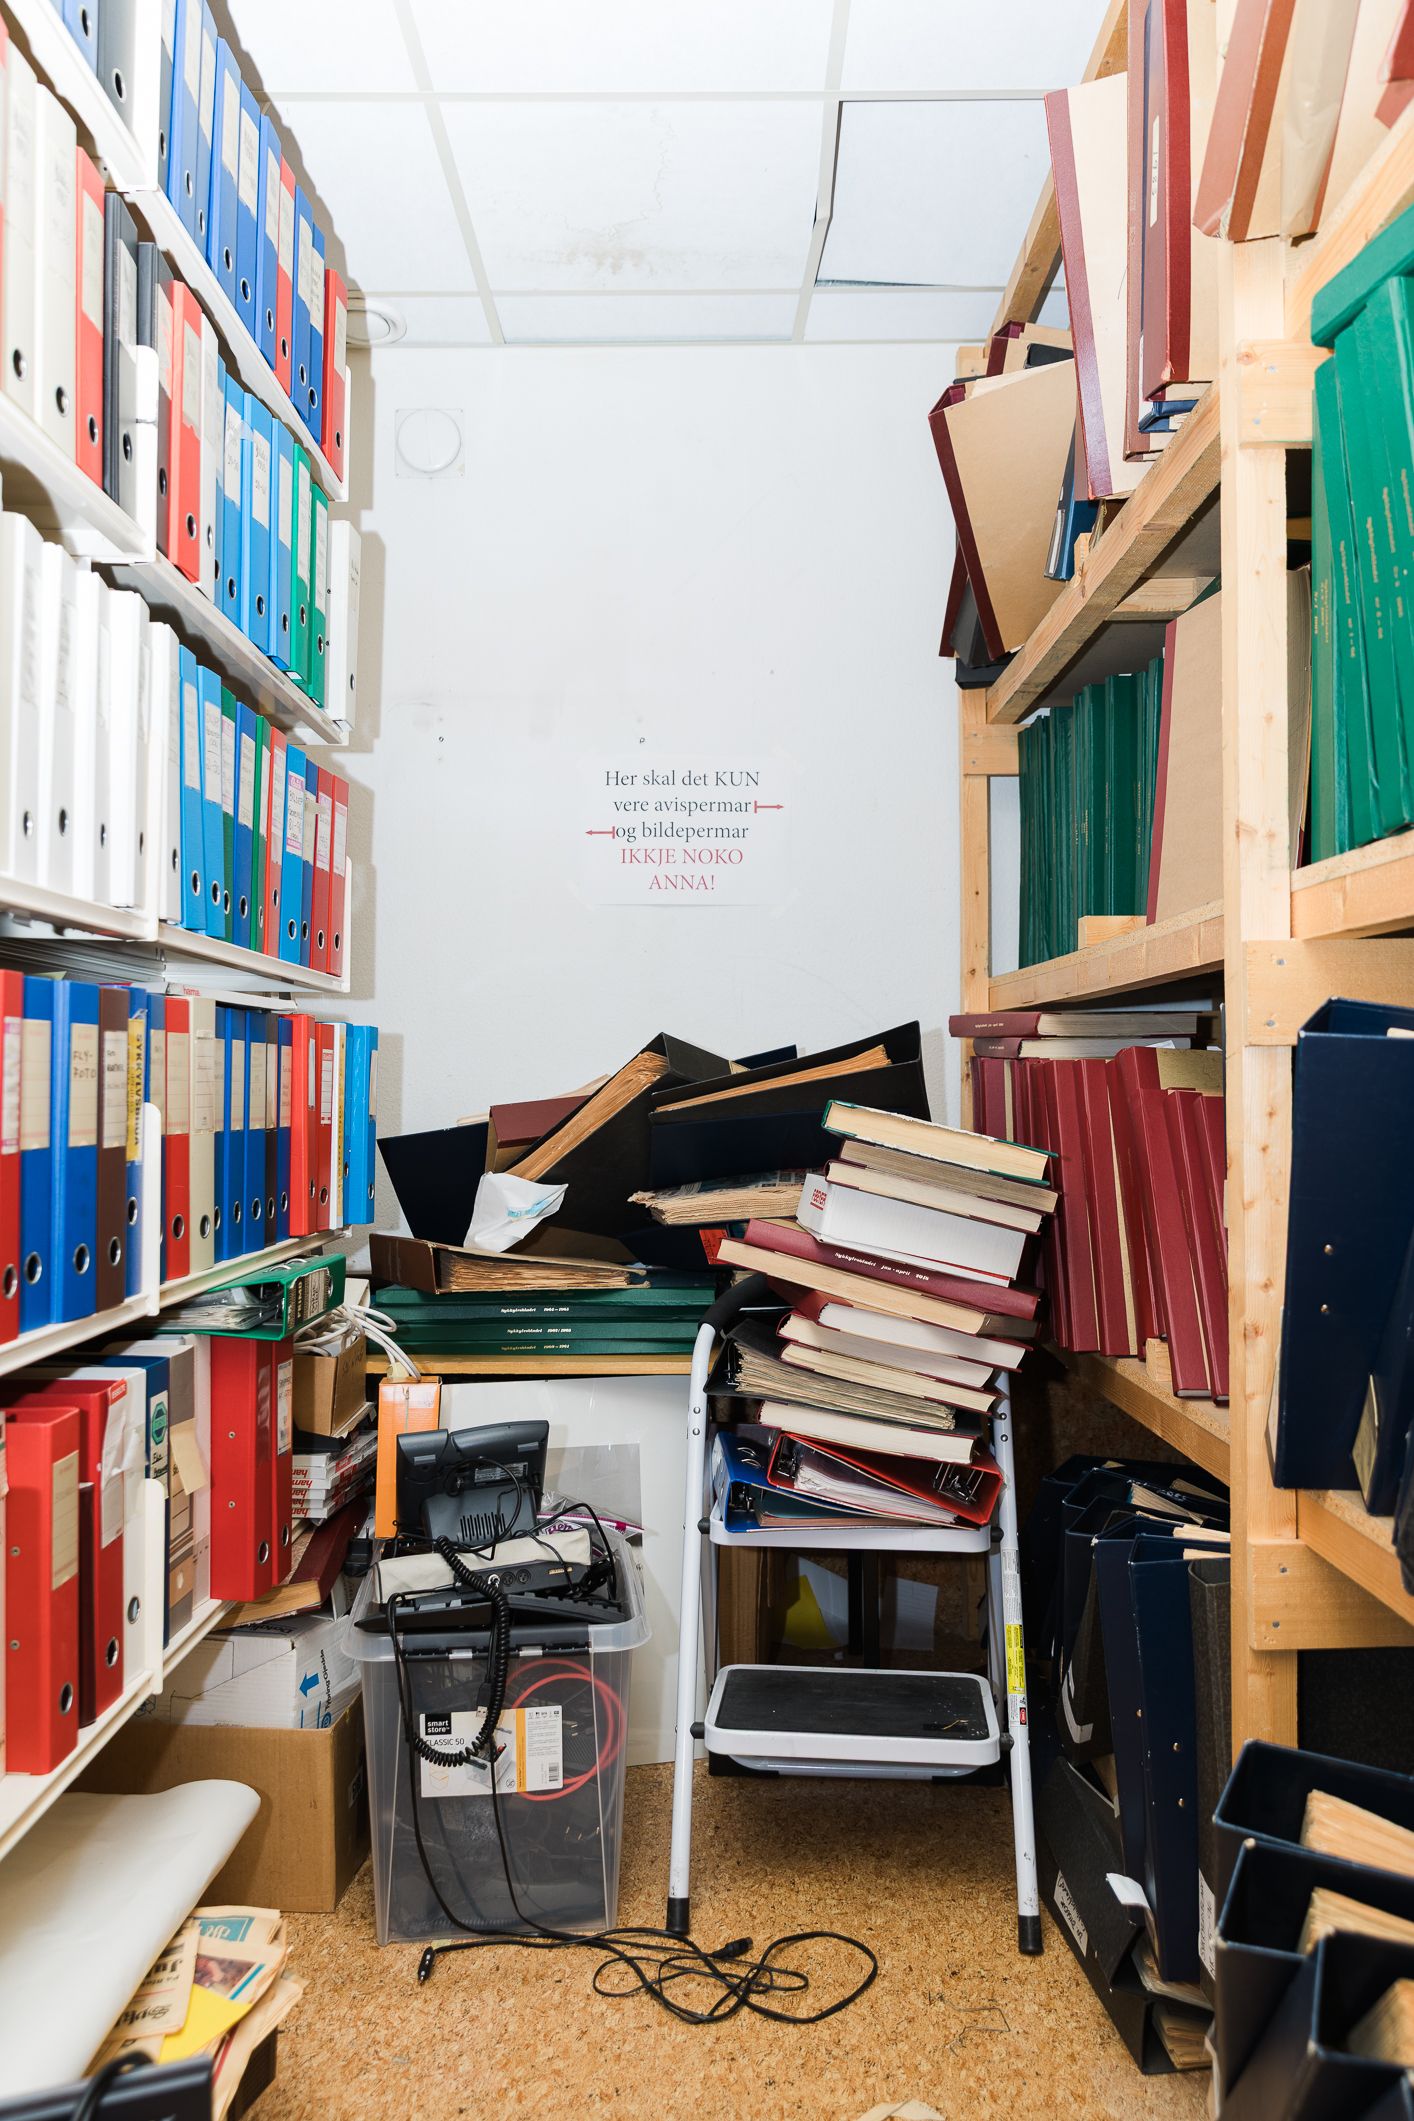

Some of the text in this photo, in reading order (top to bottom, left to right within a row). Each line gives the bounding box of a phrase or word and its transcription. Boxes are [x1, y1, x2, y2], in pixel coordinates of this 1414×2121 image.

[605, 769, 761, 787] Her skal det KUN
[613, 797, 752, 817] vere avispermar
[616, 821, 750, 843] og bildepermar
[620, 848, 744, 867] IKKJE NOKO
[648, 874, 715, 890] ANNA!
[455, 1737, 465, 1746] 50
